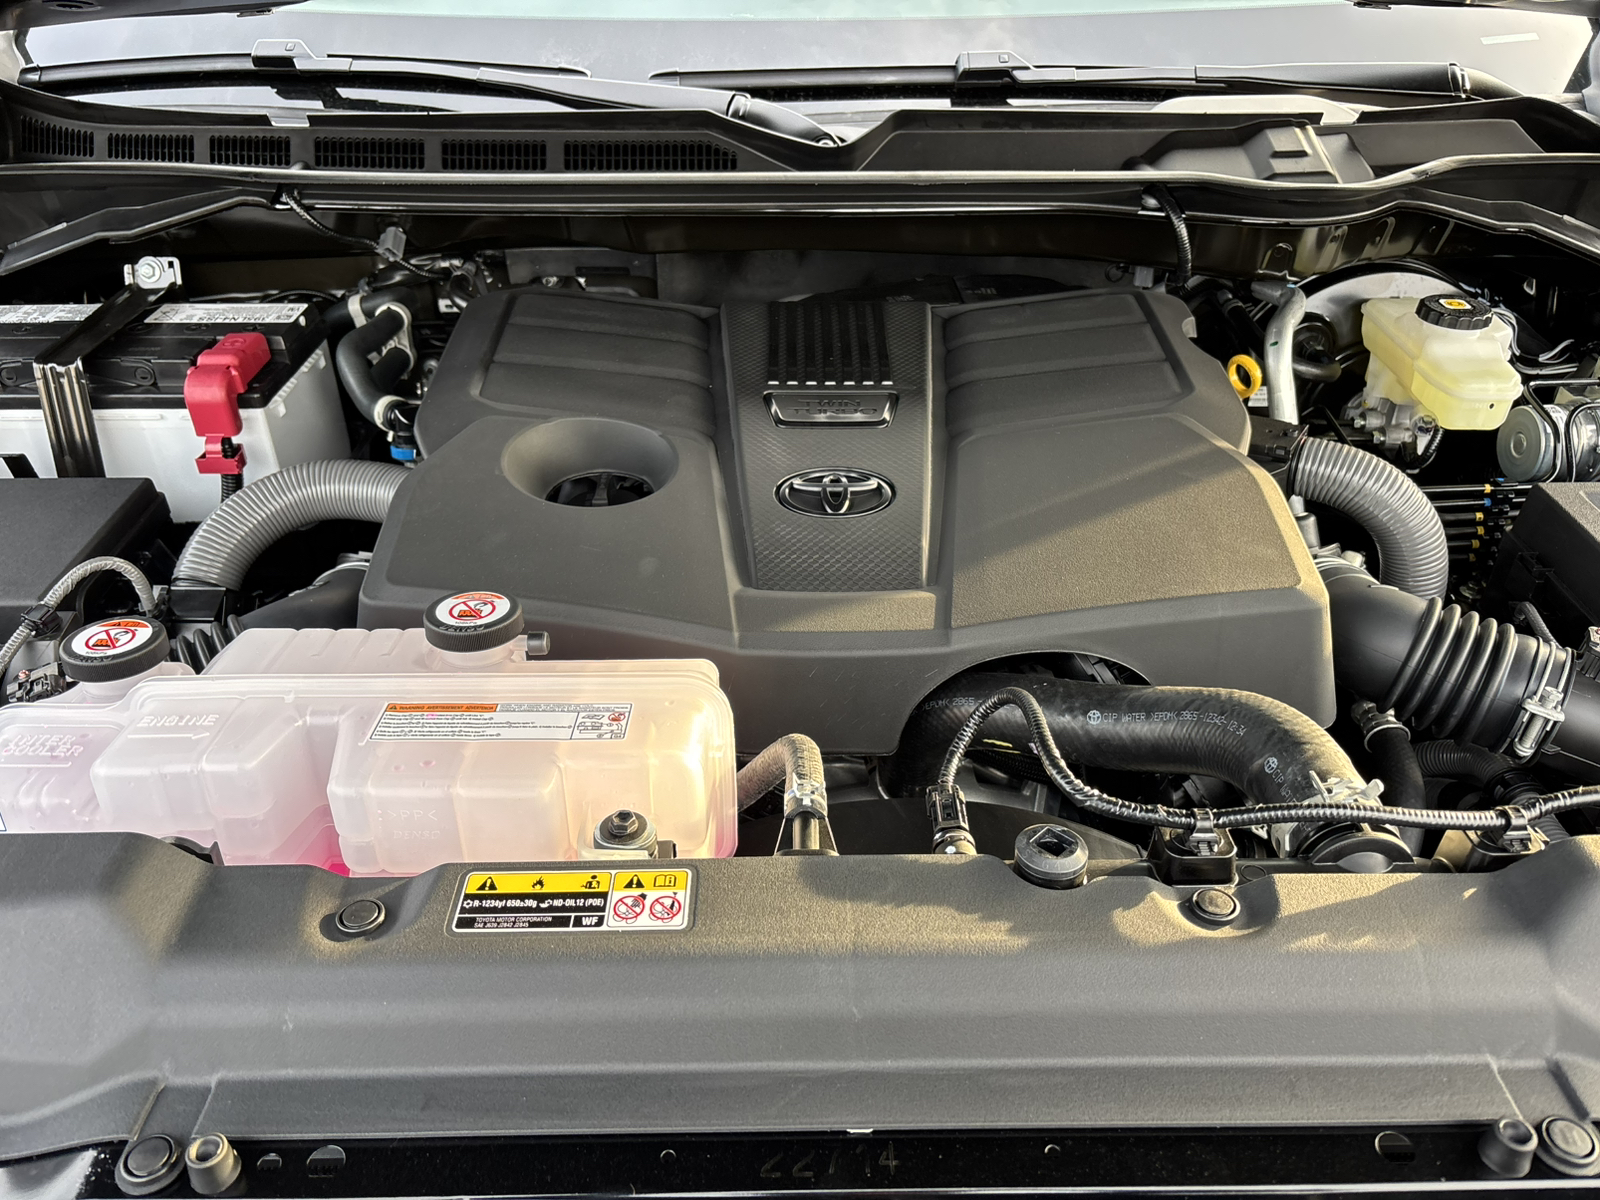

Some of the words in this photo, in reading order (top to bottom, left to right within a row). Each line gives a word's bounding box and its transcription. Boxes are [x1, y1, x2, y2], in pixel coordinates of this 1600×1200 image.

[798, 399, 861, 407] TWIN
[787, 407, 878, 415] TURBO
[136, 714, 220, 727] ENGINE
[1102, 713, 1118, 722] CIP
[1122, 713, 1146, 722] WATER
[9, 735, 76, 746] INTER
[2, 745, 84, 757] COOLER
[473, 899, 506, 909] R-1234yf
[506, 898, 538, 910] 650±30g
[585, 898, 604, 907] (POE)
[581, 917, 598, 926] WF
